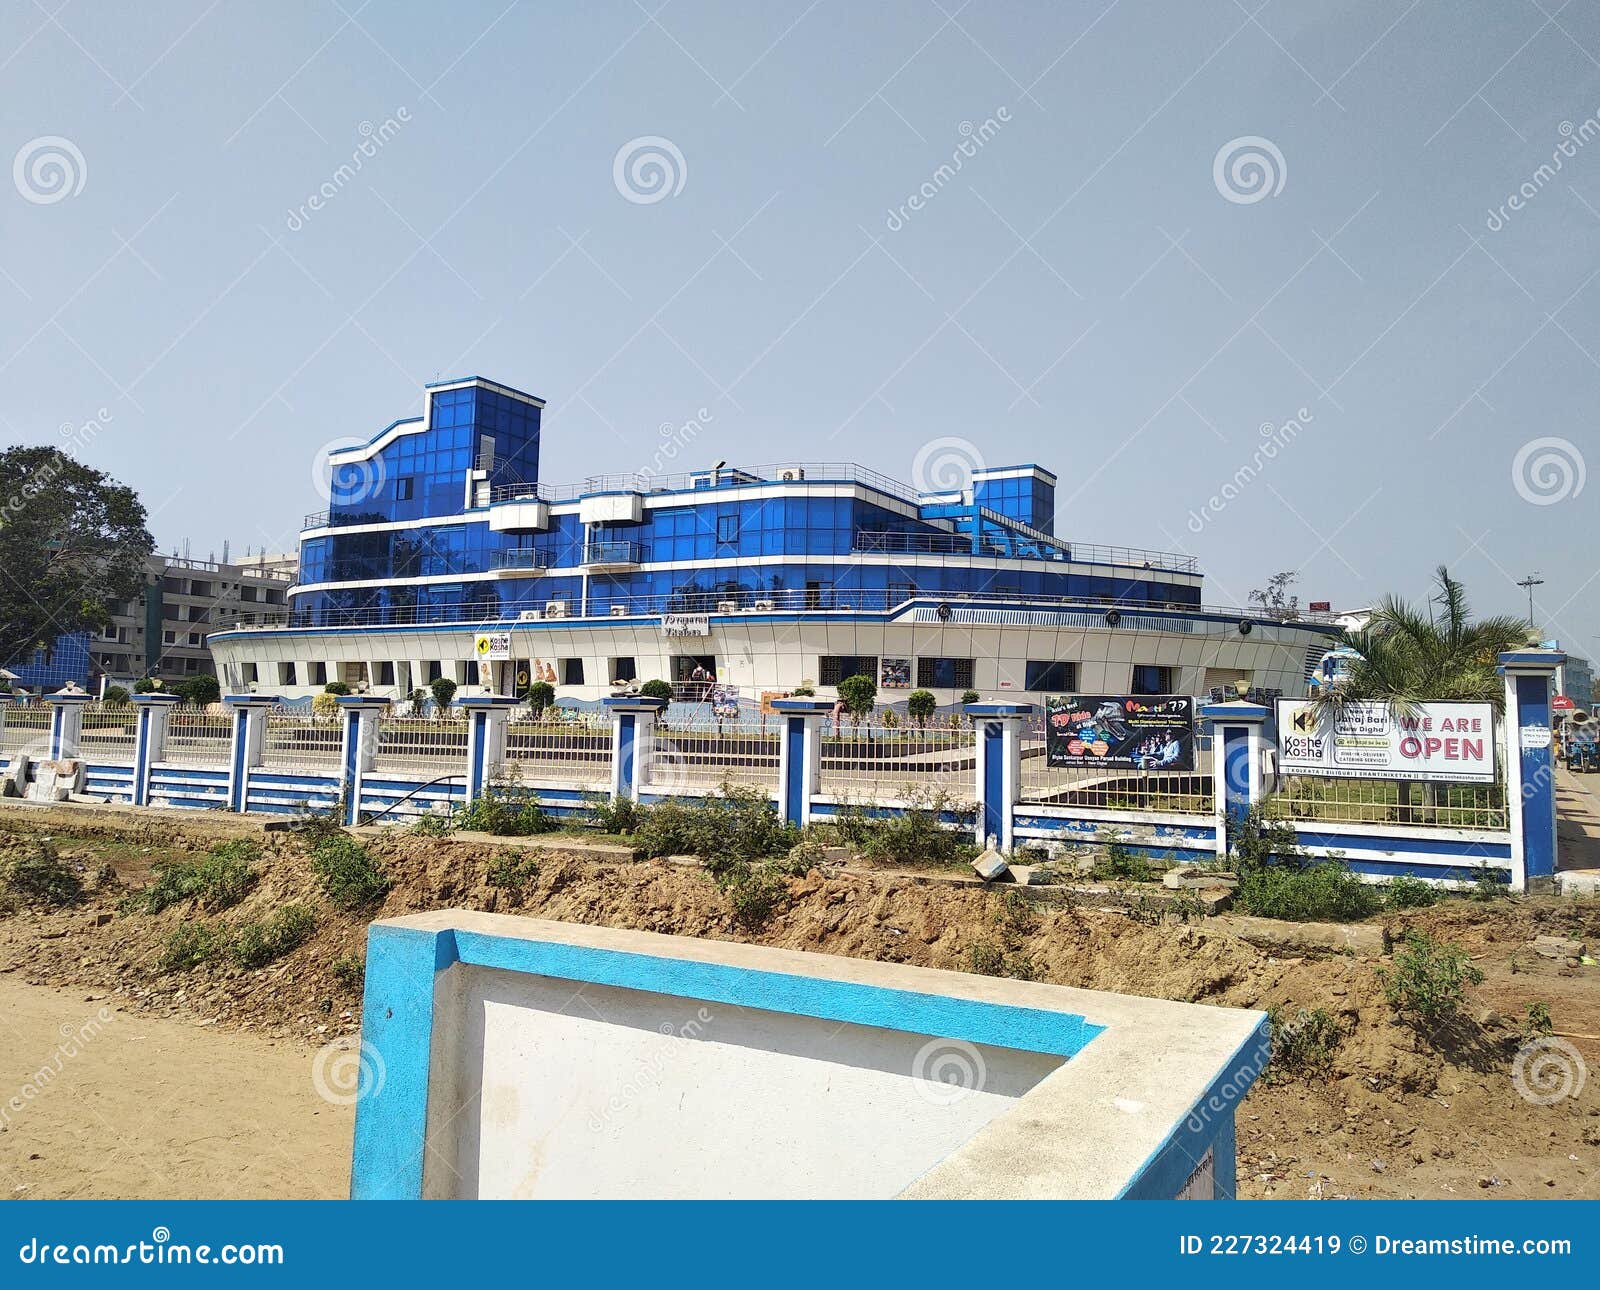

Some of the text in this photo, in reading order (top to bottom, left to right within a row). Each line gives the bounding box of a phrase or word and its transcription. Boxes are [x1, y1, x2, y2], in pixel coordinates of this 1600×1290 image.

[1051, 713, 1070, 727] 7D
[1367, 715, 1388, 724] Bari
[1400, 716, 1482, 732] WE ARE
[1285, 736, 1321, 748] Koshe
[1399, 736, 1484, 761] OPEN
[1285, 746, 1322, 758] Kosha
